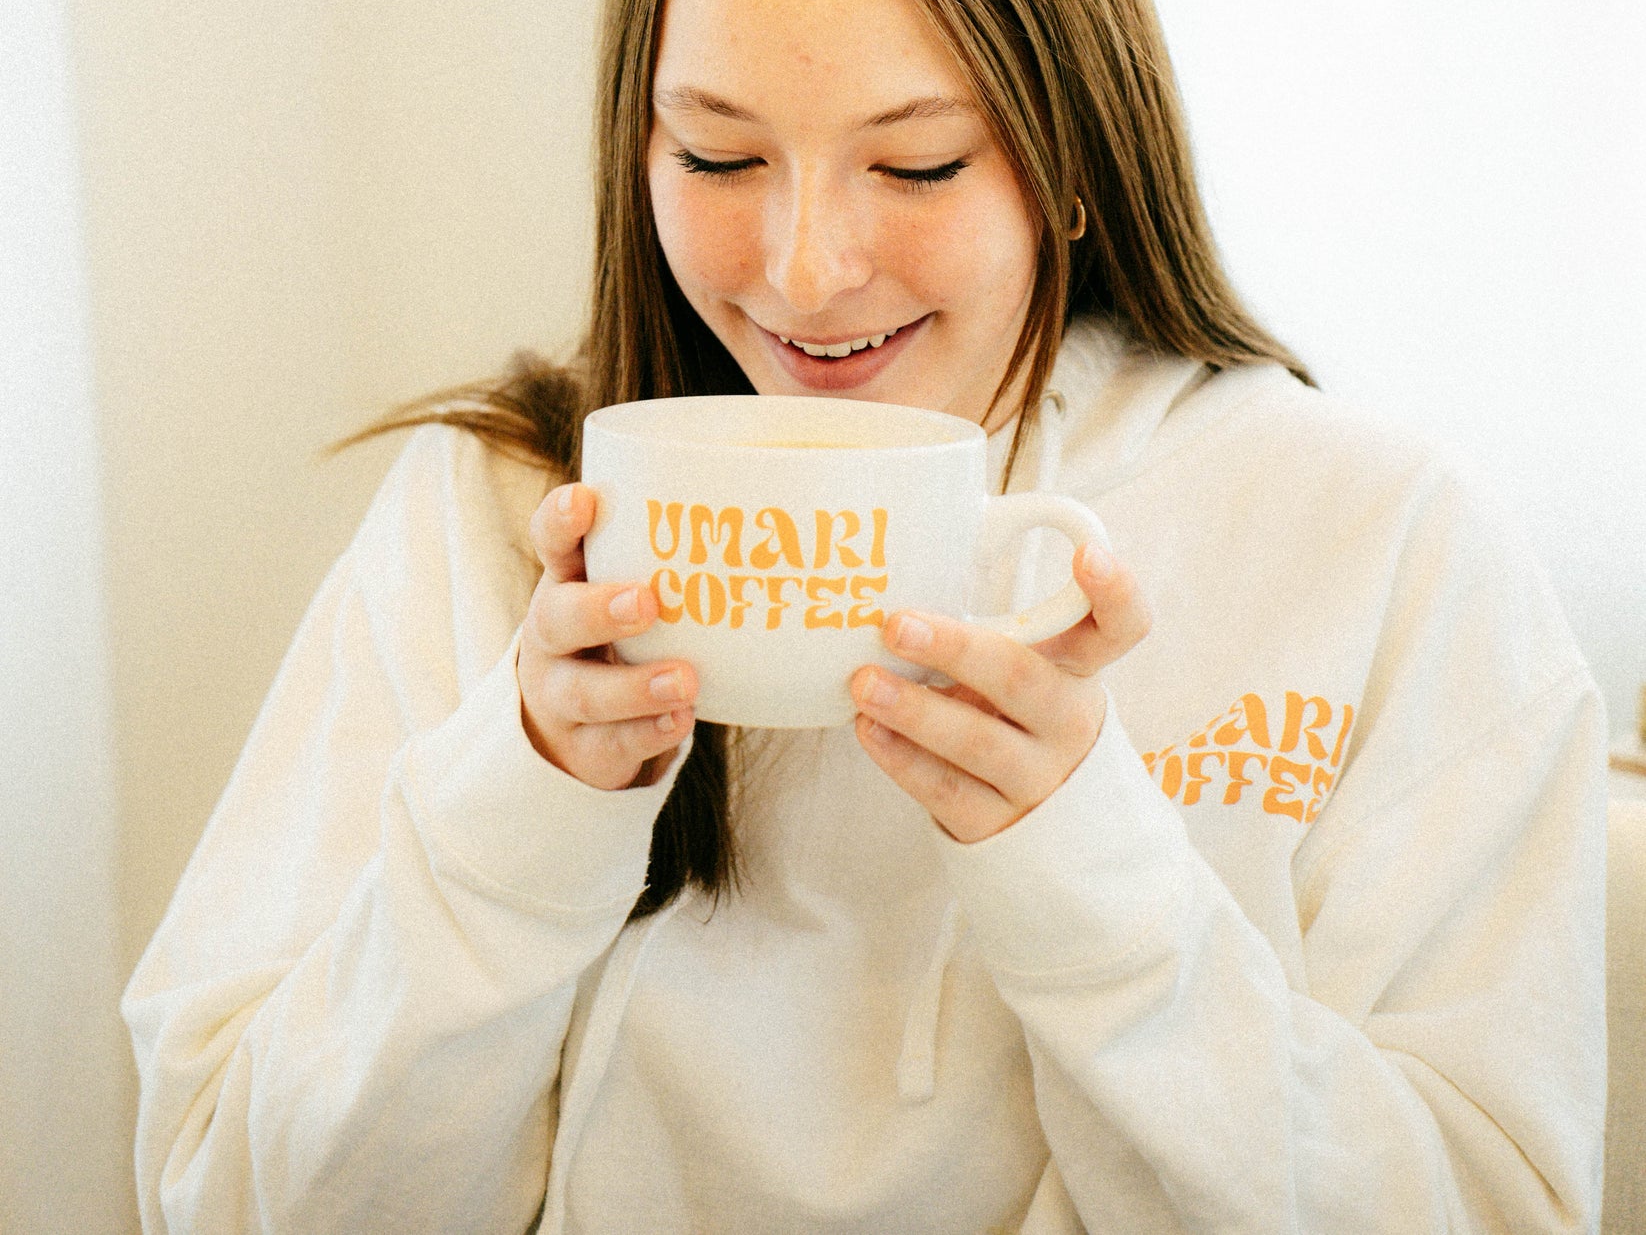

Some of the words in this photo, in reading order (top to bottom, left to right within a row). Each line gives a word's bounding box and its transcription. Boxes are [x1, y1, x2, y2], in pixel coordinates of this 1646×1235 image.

[646, 499, 889, 570] UMARI
[649, 568, 889, 631] COFFEE
[1142, 690, 1354, 767] ARI
[1141, 751, 1335, 823] OFFEE
